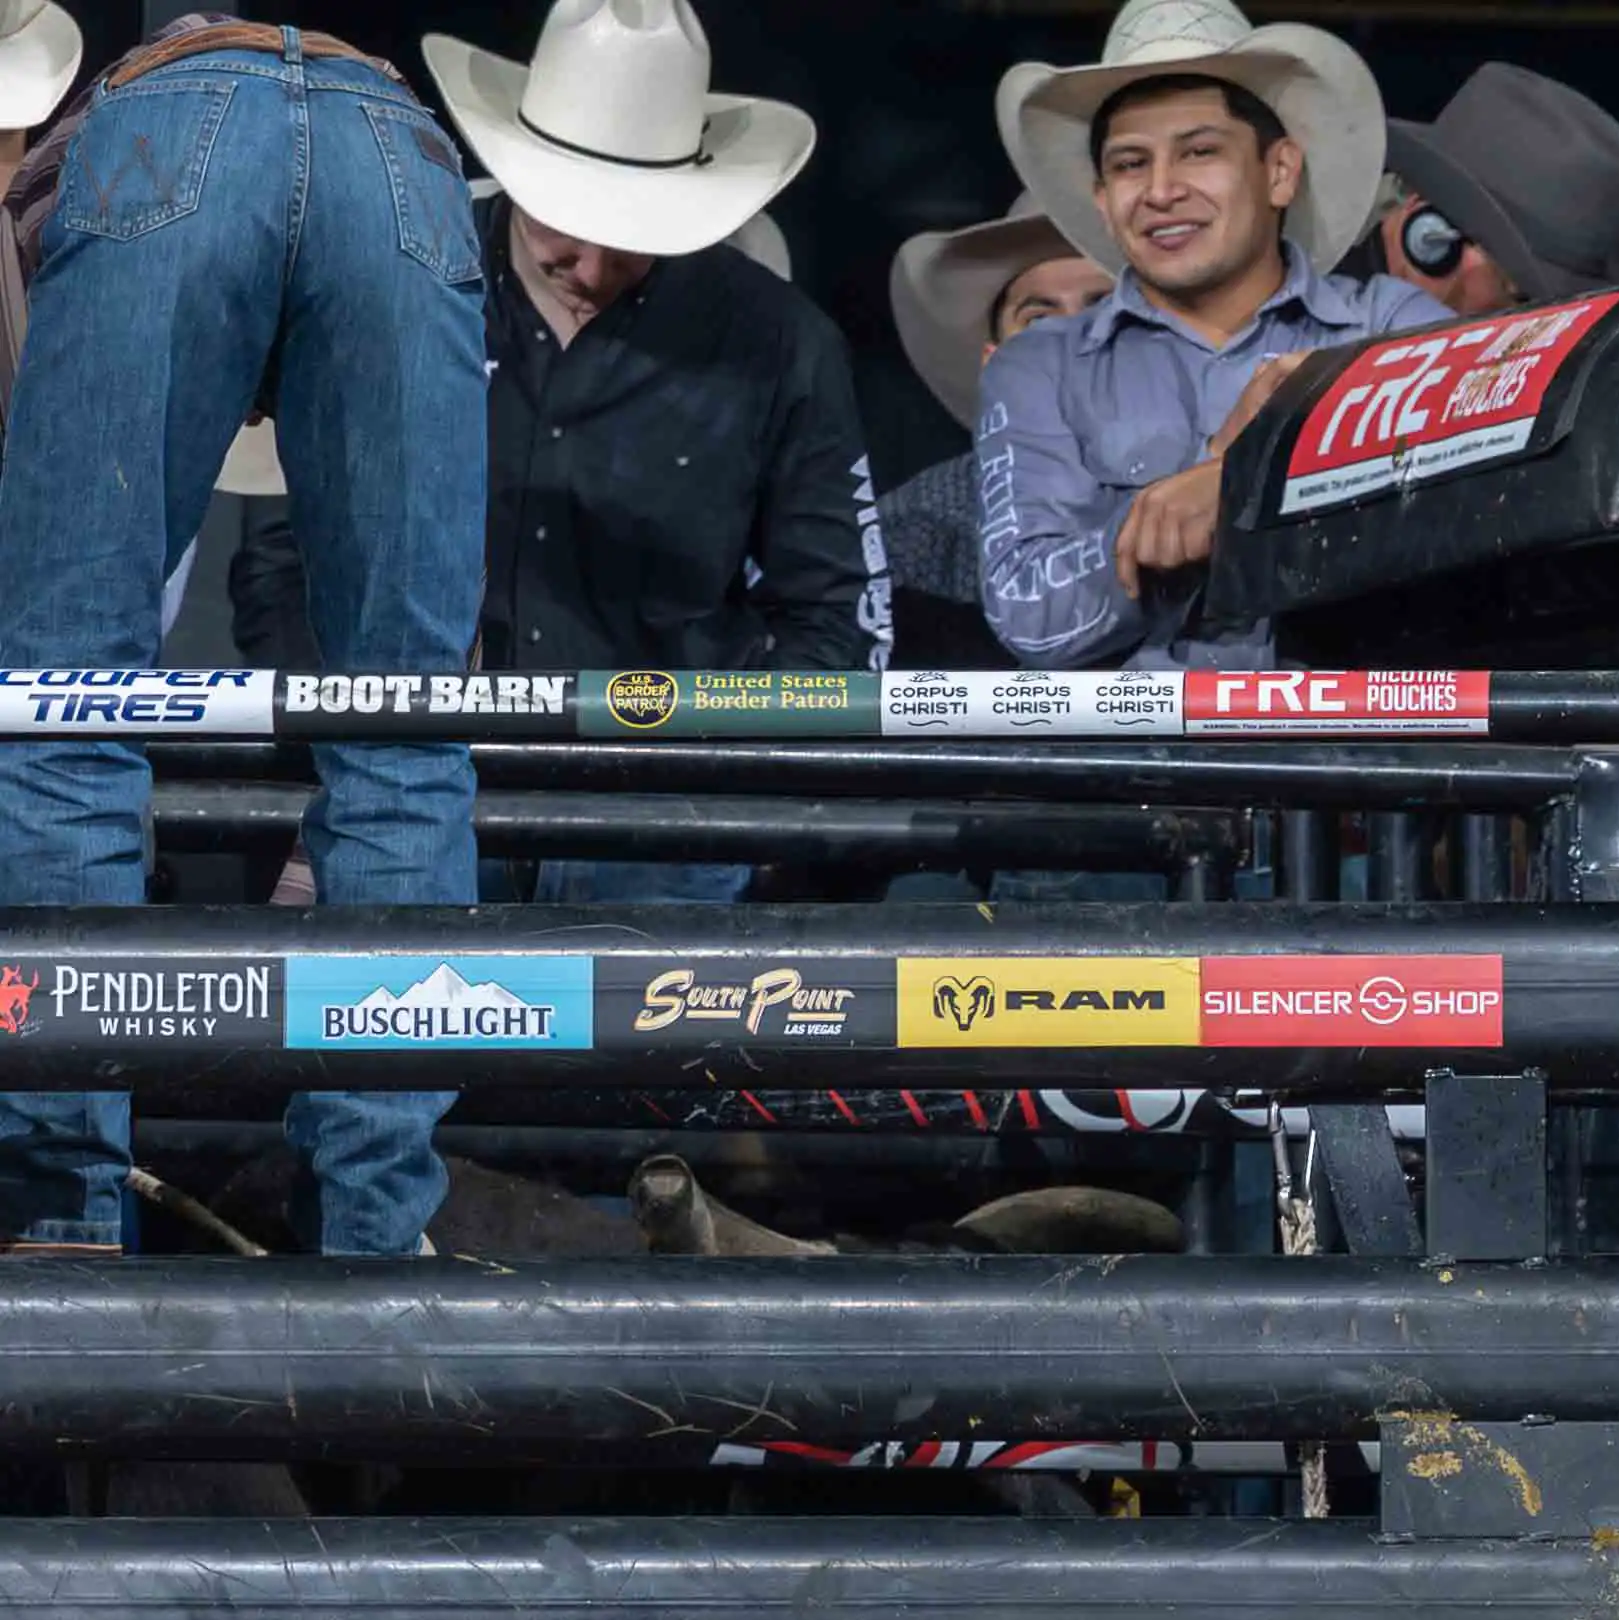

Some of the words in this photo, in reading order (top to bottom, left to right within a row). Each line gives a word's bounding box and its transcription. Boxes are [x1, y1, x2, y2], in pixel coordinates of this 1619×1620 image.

[1317, 326, 1496, 456] FRE
[0, 671, 254, 687] COOPER
[695, 675, 772, 689] United
[781, 675, 848, 689] States
[1367, 671, 1457, 684] NICOTINE
[286, 675, 421, 713] BOOT
[615, 684, 670, 698] BORDER
[694, 691, 770, 709] Border
[780, 689, 848, 709] Patrol
[890, 686, 968, 698] CORPUS
[993, 686, 1071, 698] CORPUS
[1096, 686, 1174, 698] CORPUS
[1216, 671, 1347, 712] FRE
[1366, 685, 1457, 711] POUCHES
[28, 694, 209, 722] TIRES
[615, 697, 667, 711] PATROL
[890, 701, 968, 715] CHRISTI
[993, 701, 1071, 715] CHRISTI
[1096, 701, 1174, 715] CHRISTI
[50, 965, 269, 1018] PENDLETON
[1005, 990, 1165, 1010] RAM
[633, 969, 749, 1031] SOUTH
[746, 968, 856, 1035] POINT
[1204, 991, 1353, 1014] SILENCER
[1412, 991, 1499, 1014] SHOP
[99, 1017, 217, 1036] WHISKY
[323, 1006, 433, 1038] BUSCH
[440, 1007, 553, 1036] LIGHT
[784, 1024, 806, 1035] LAS
[807, 1024, 842, 1035] VEGAS
